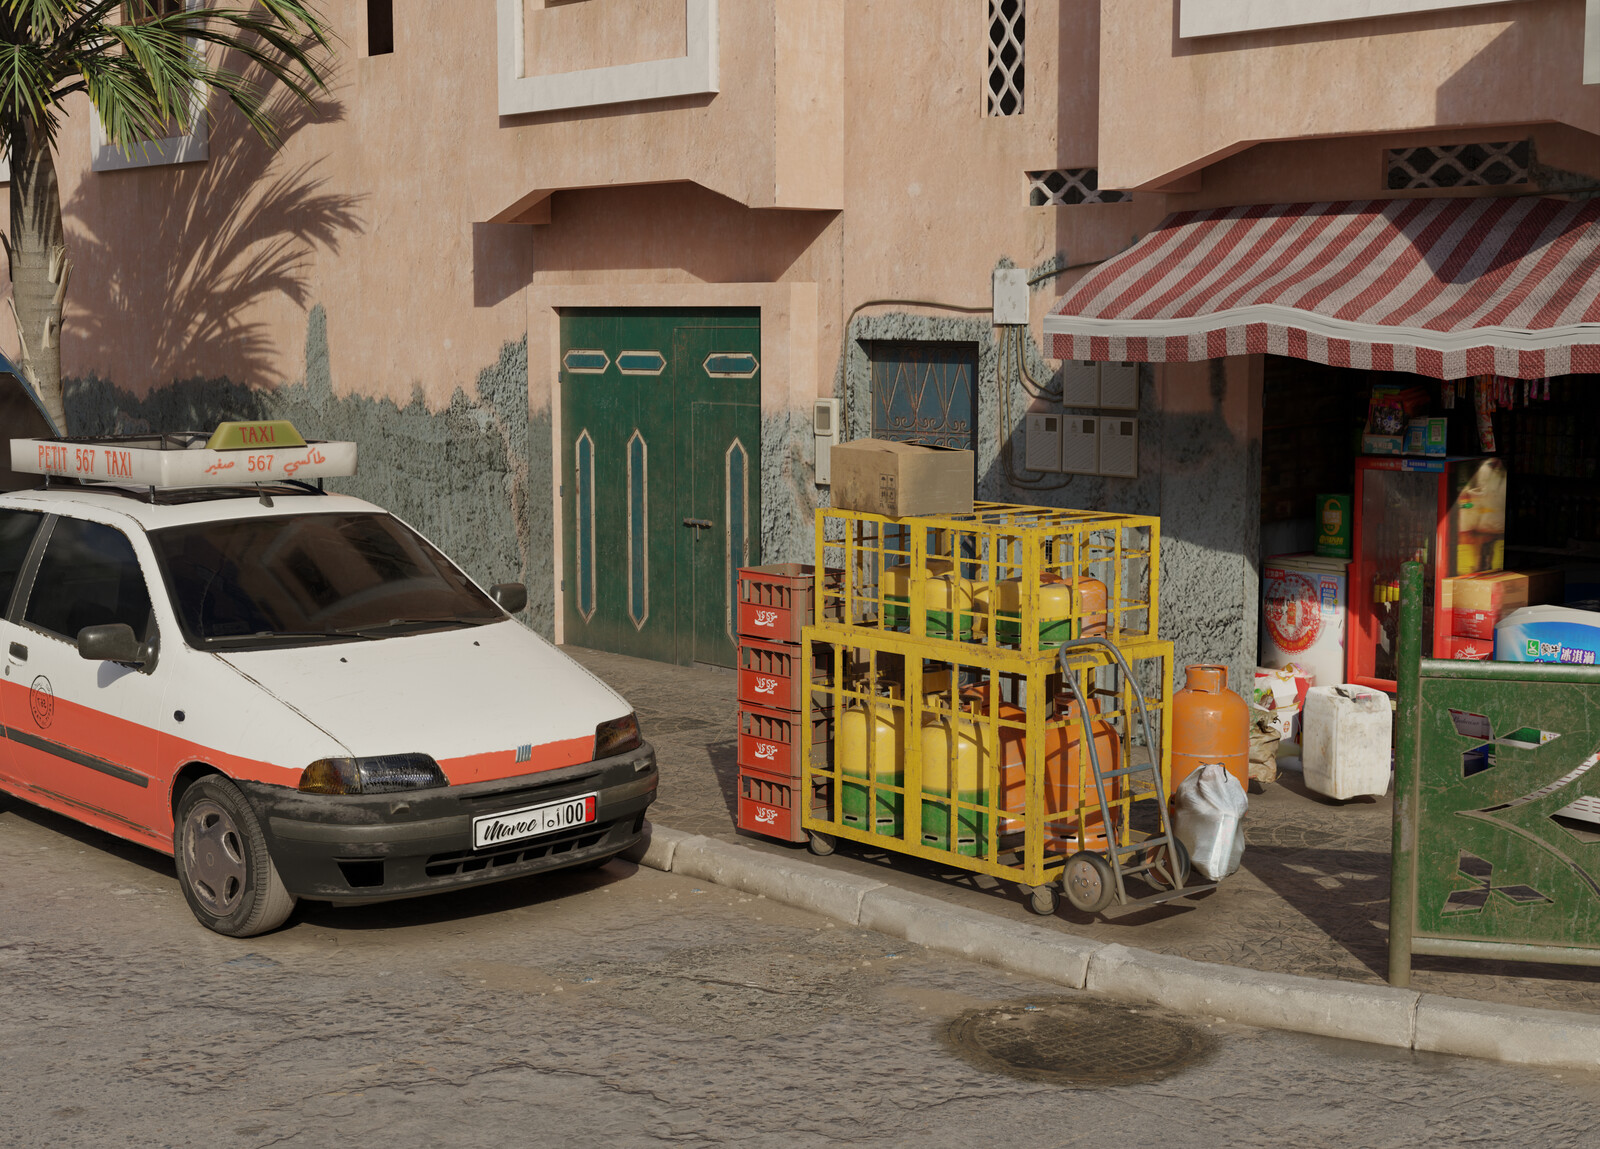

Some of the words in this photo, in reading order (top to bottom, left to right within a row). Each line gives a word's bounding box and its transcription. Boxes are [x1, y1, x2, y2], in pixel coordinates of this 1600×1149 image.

[239, 426, 274, 443] TAXI
[38, 445, 68, 472] PETIT
[76, 448, 96, 473] 567
[104, 450, 132, 478] TAXI
[204, 458, 235, 475] صغير
[247, 454, 274, 472] 567
[283, 447, 326, 476] طاكسي
[566, 802, 583, 824] 00
[484, 819, 538, 841] Maroc
